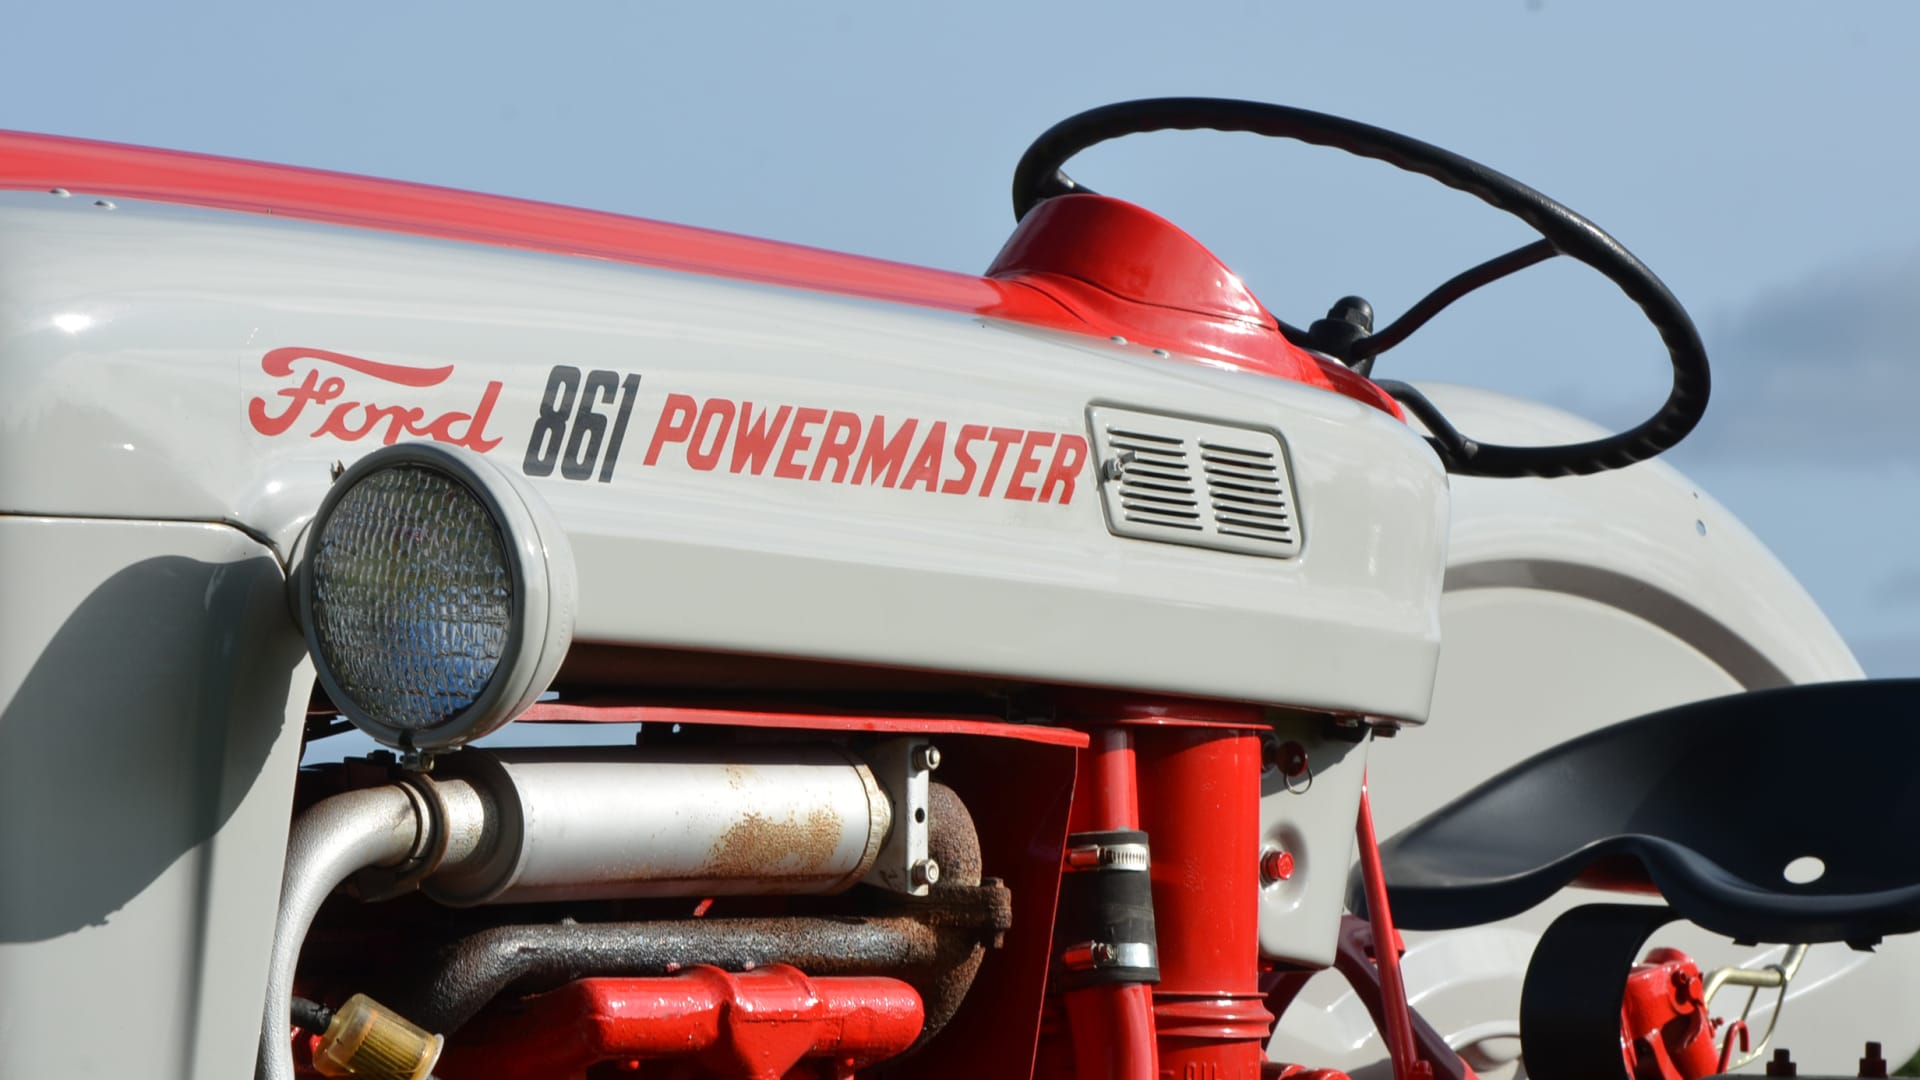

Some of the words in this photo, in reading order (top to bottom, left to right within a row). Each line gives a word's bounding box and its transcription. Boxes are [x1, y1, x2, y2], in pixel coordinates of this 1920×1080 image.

[249, 347, 503, 454] Ford
[523, 365, 642, 483] 861
[643, 393, 1088, 505] POWERMASTER
